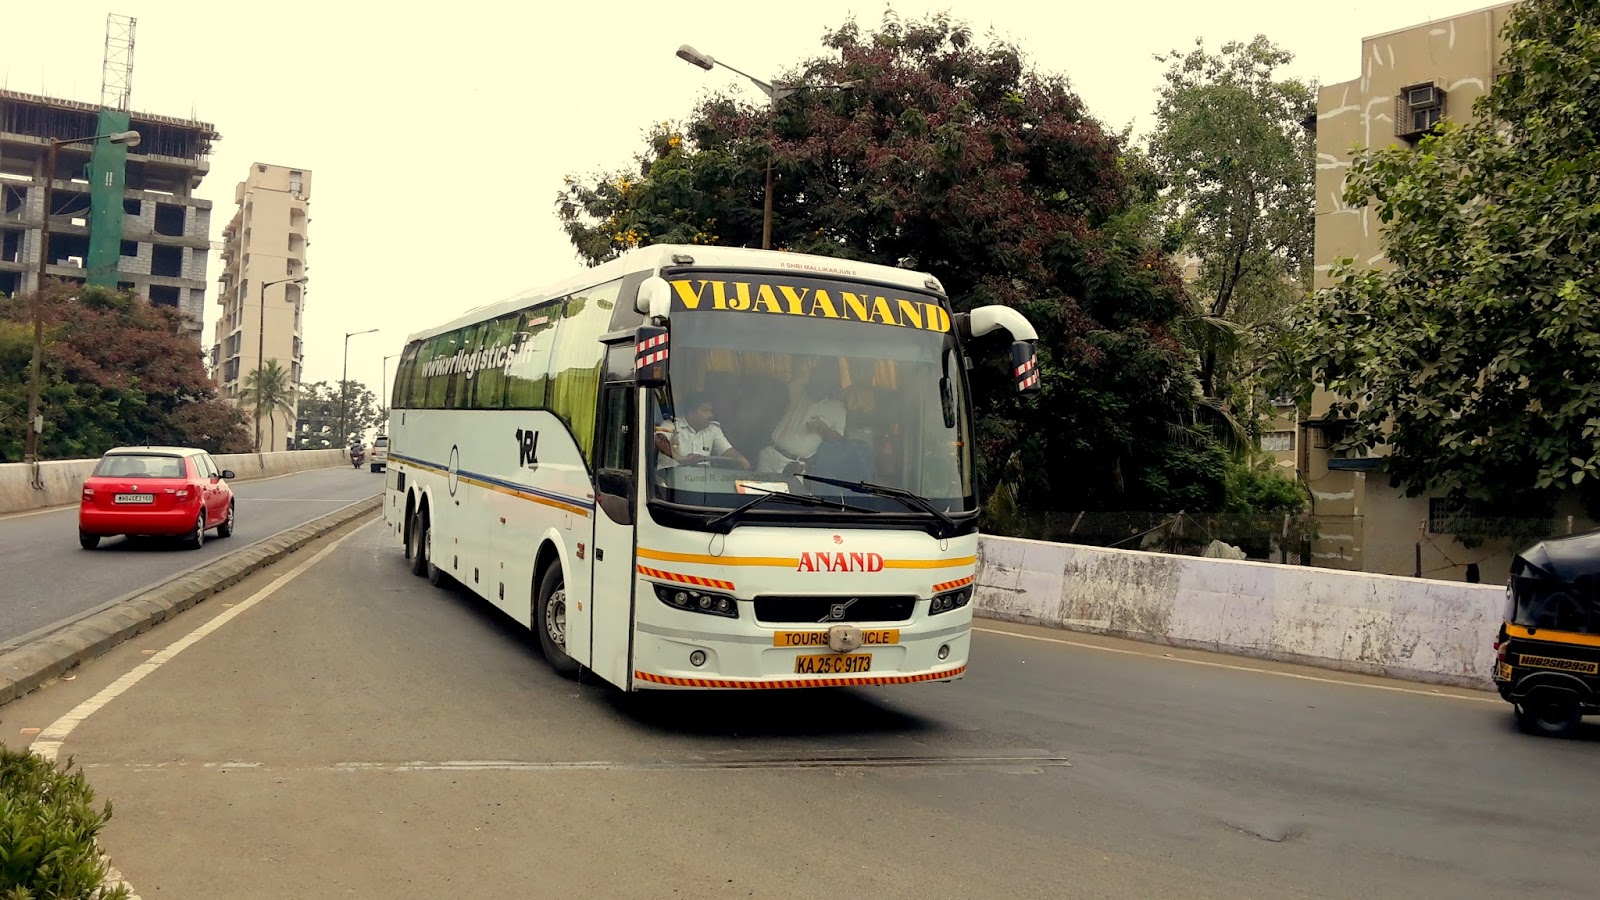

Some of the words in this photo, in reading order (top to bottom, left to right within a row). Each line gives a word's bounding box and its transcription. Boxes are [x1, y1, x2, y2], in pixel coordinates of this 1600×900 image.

[804, 265, 851, 275] MALLIKARJUN
[669, 279, 950, 333] VIJAYANAND
[797, 552, 884, 572] ANAND
[785, 632, 829, 645] TOURIS
